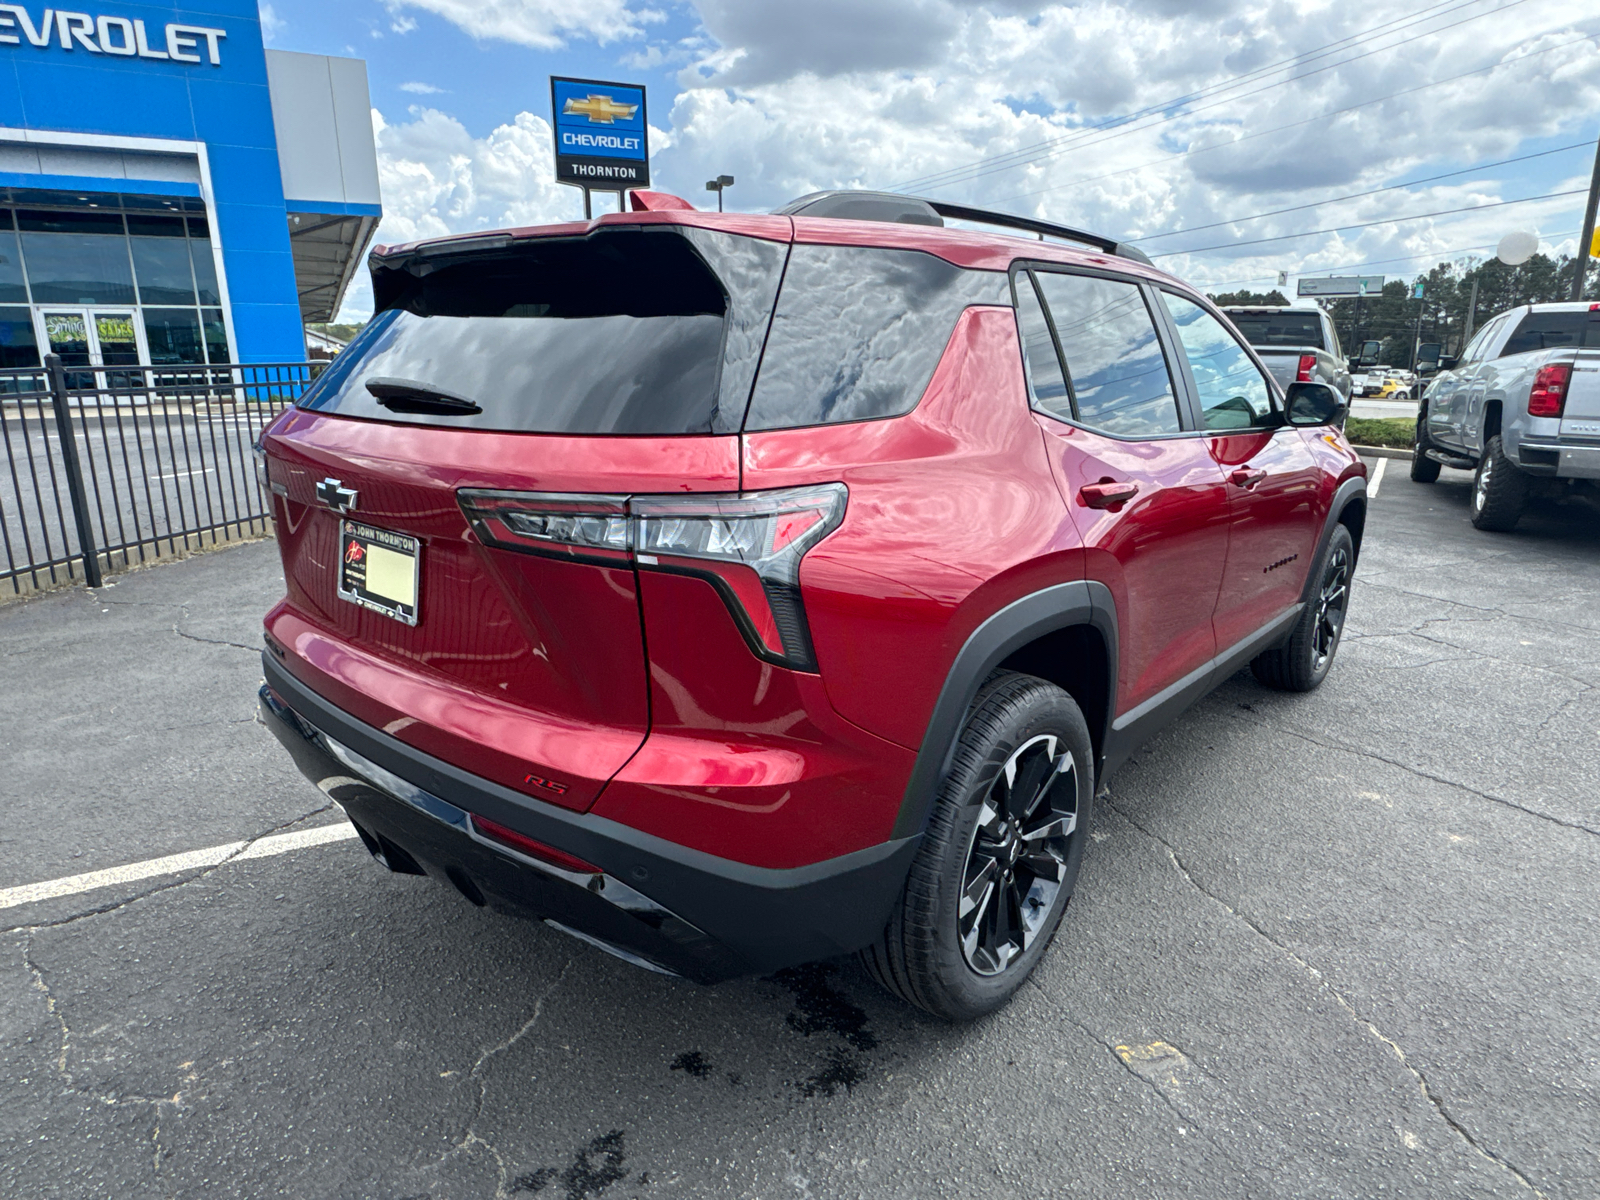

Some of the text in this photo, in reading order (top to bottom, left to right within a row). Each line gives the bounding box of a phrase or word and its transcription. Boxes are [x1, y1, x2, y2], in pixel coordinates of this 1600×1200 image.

[563, 132, 640, 150] CHEVROLET
[571, 164, 636, 178] THORNTON
[356, 526, 414, 551] JOHN THORNTON
[523, 773, 569, 795] RS
